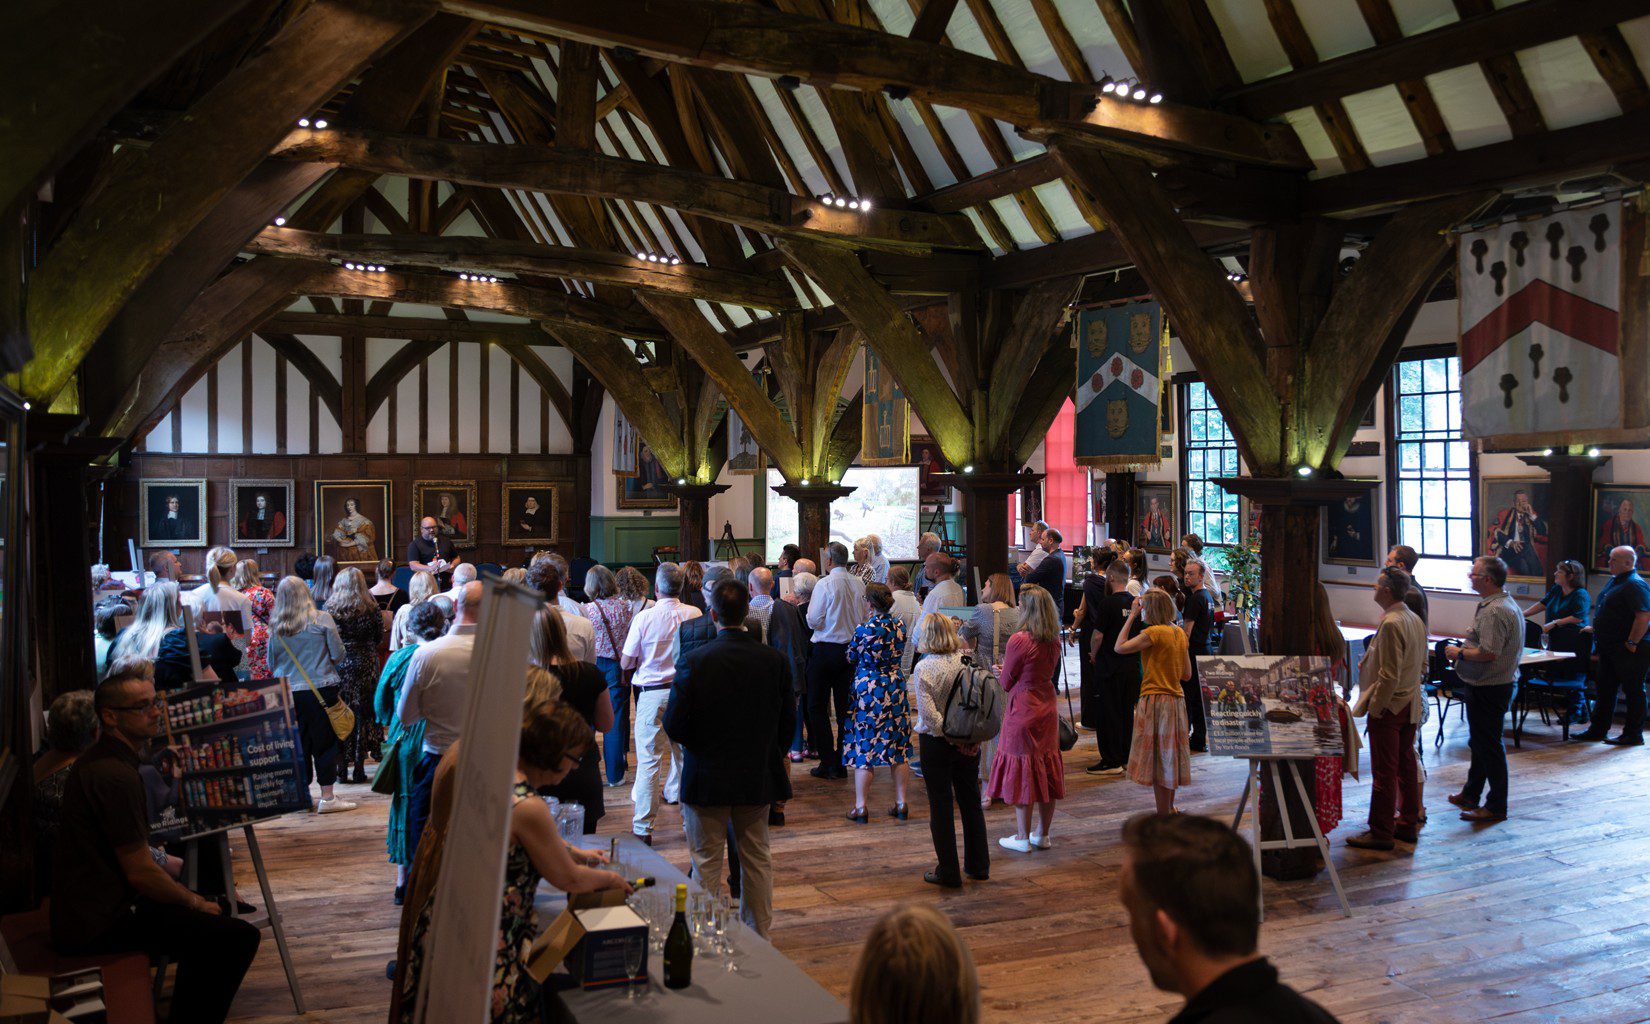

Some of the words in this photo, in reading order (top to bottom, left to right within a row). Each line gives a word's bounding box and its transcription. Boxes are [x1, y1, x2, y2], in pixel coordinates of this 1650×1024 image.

[1240, 709, 1262, 719] quickly
[247, 743, 265, 754] Cost
[266, 742, 273, 751] of
[274, 740, 295, 749] living
[250, 754, 280, 767] support
[253, 772, 274, 781] Raising
[274, 768, 293, 777] money
[258, 799, 278, 809] impact
